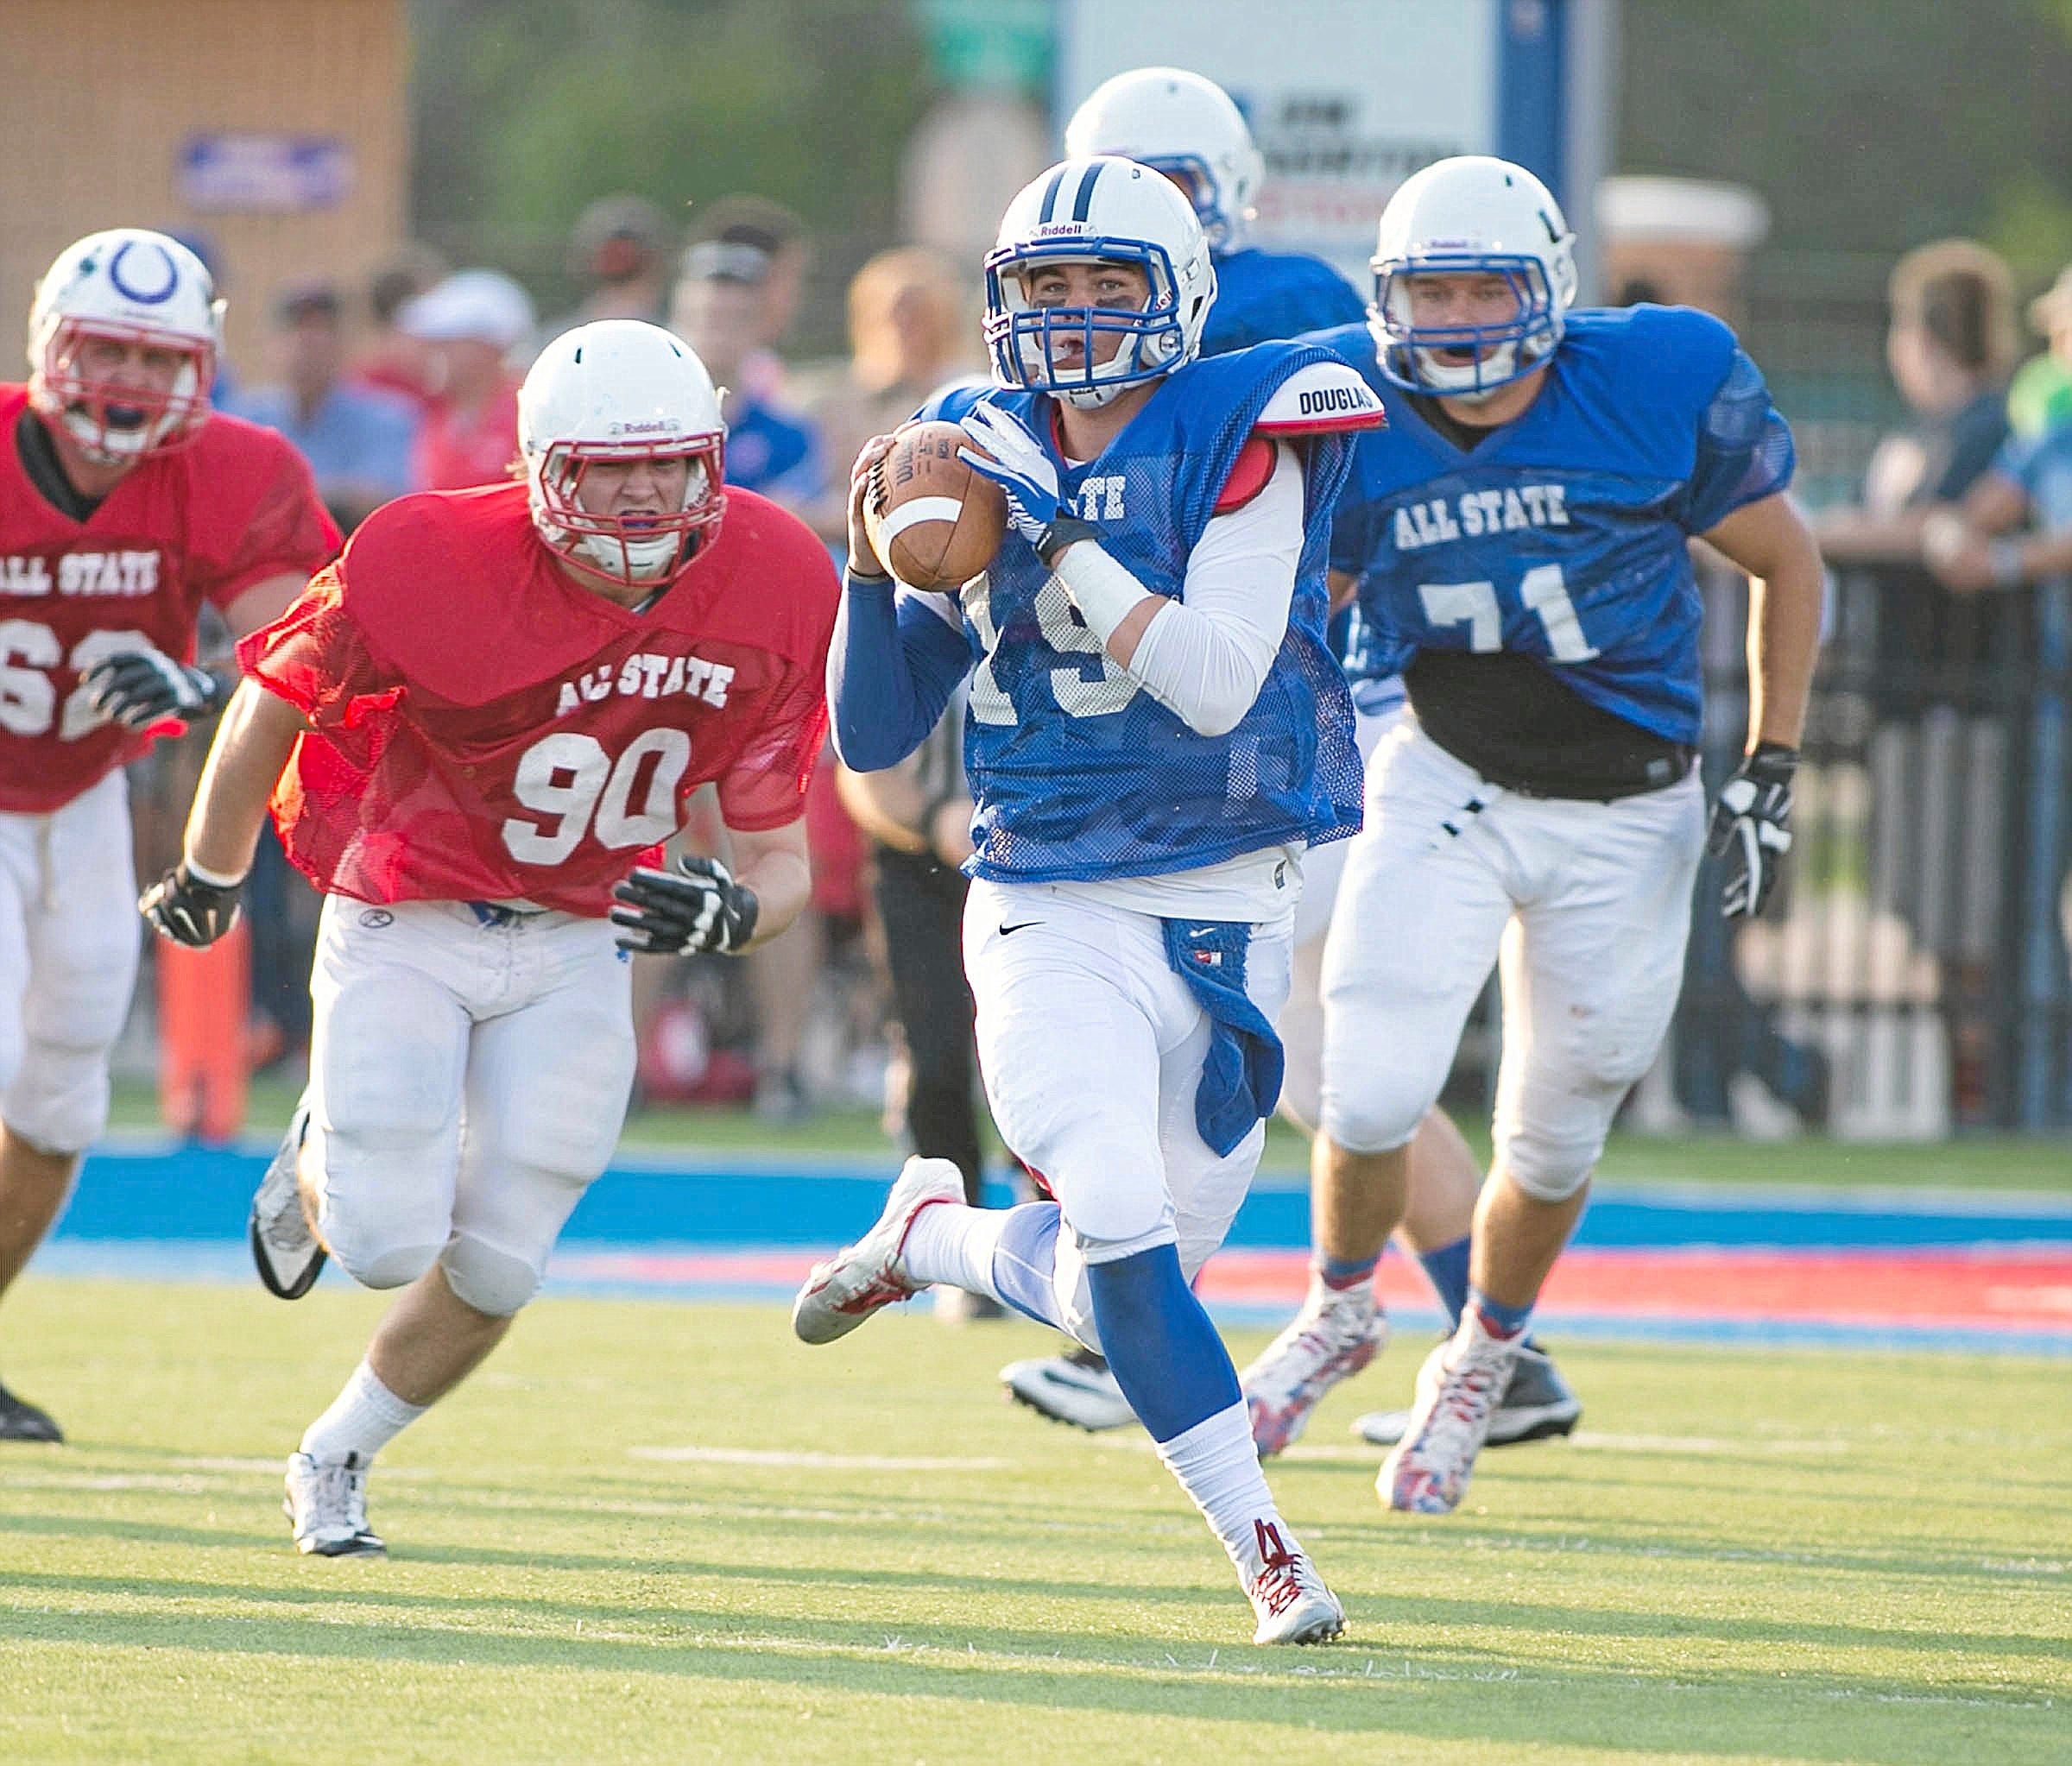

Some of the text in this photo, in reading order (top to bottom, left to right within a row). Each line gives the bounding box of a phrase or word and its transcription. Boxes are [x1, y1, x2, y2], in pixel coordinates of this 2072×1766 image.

[1041, 224, 1082, 237] Riddell
[1299, 387, 1373, 414] DOUGLAS
[1395, 484, 1570, 550] ALL STATE
[58, 550, 160, 596] STATE
[1418, 564, 1601, 665] 71
[959, 571, 1143, 726] 19
[617, 653, 735, 710] STATE
[502, 727, 691, 865] 90
